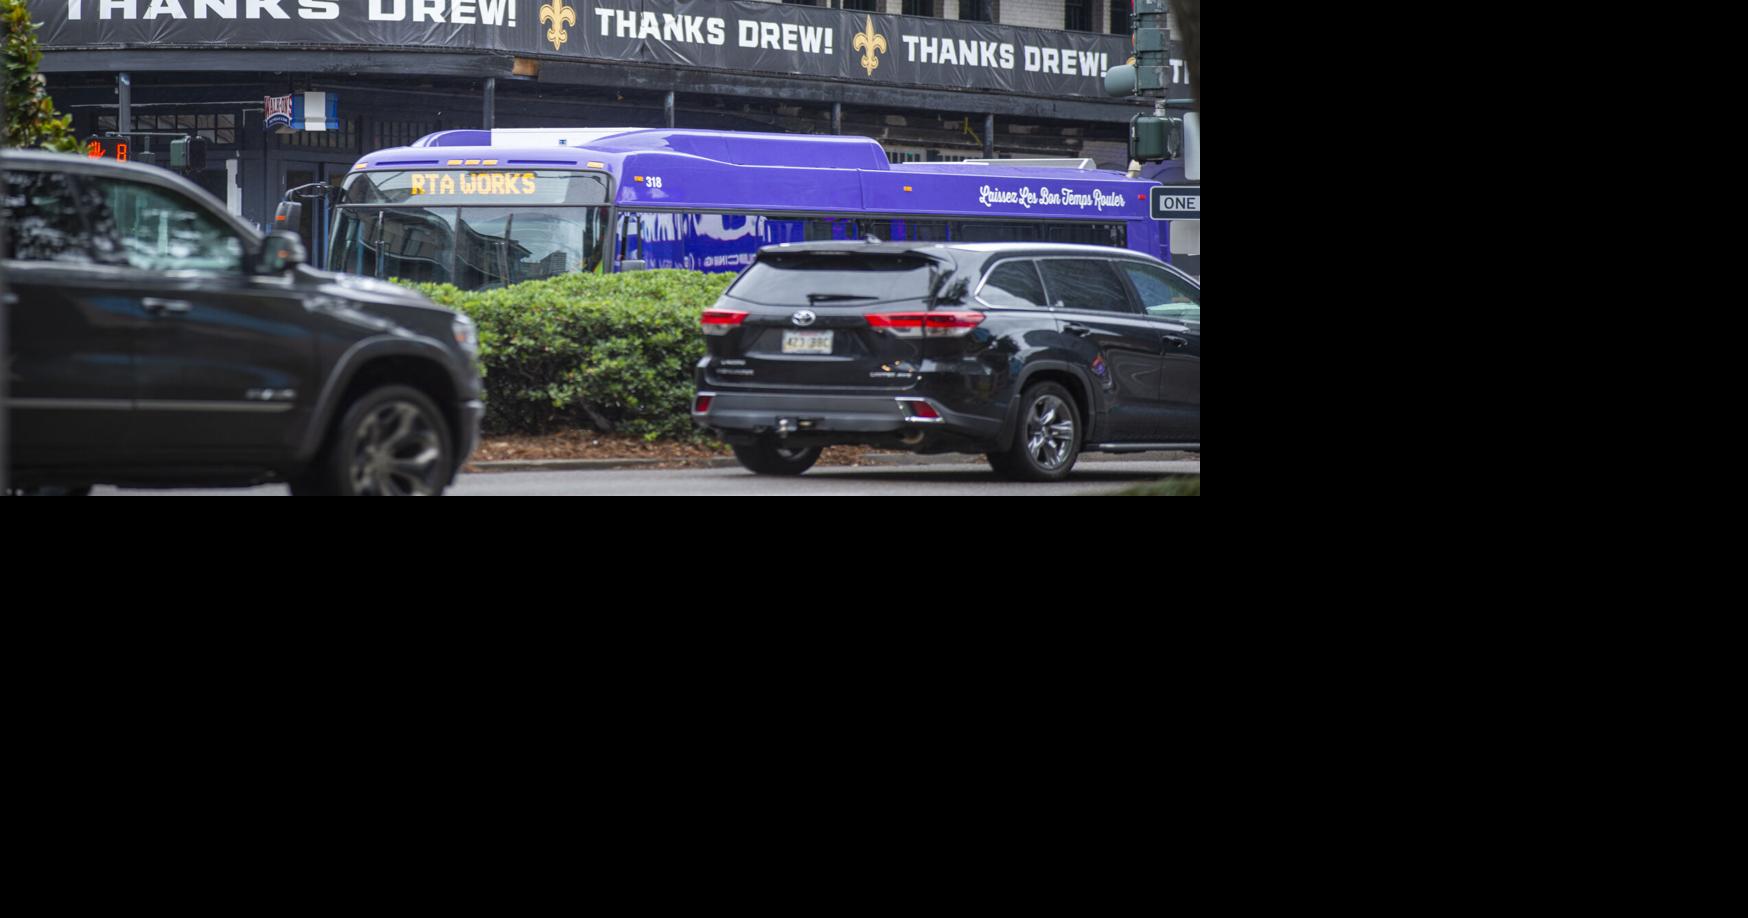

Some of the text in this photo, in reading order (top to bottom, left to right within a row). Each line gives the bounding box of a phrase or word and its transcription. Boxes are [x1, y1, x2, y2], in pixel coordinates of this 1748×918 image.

[68, 0, 517, 27] THANKS DREW!
[594, 8, 833, 55] THANKS DREW!
[902, 35, 1108, 78] THANKS DREW!
[115, 143, 128, 163] 8
[411, 172, 536, 195] RTA WORKS
[645, 176, 662, 188] 318
[979, 185, 1125, 211] Laissez Les Bon Temps Rouler
[1163, 197, 1196, 209] ONE
